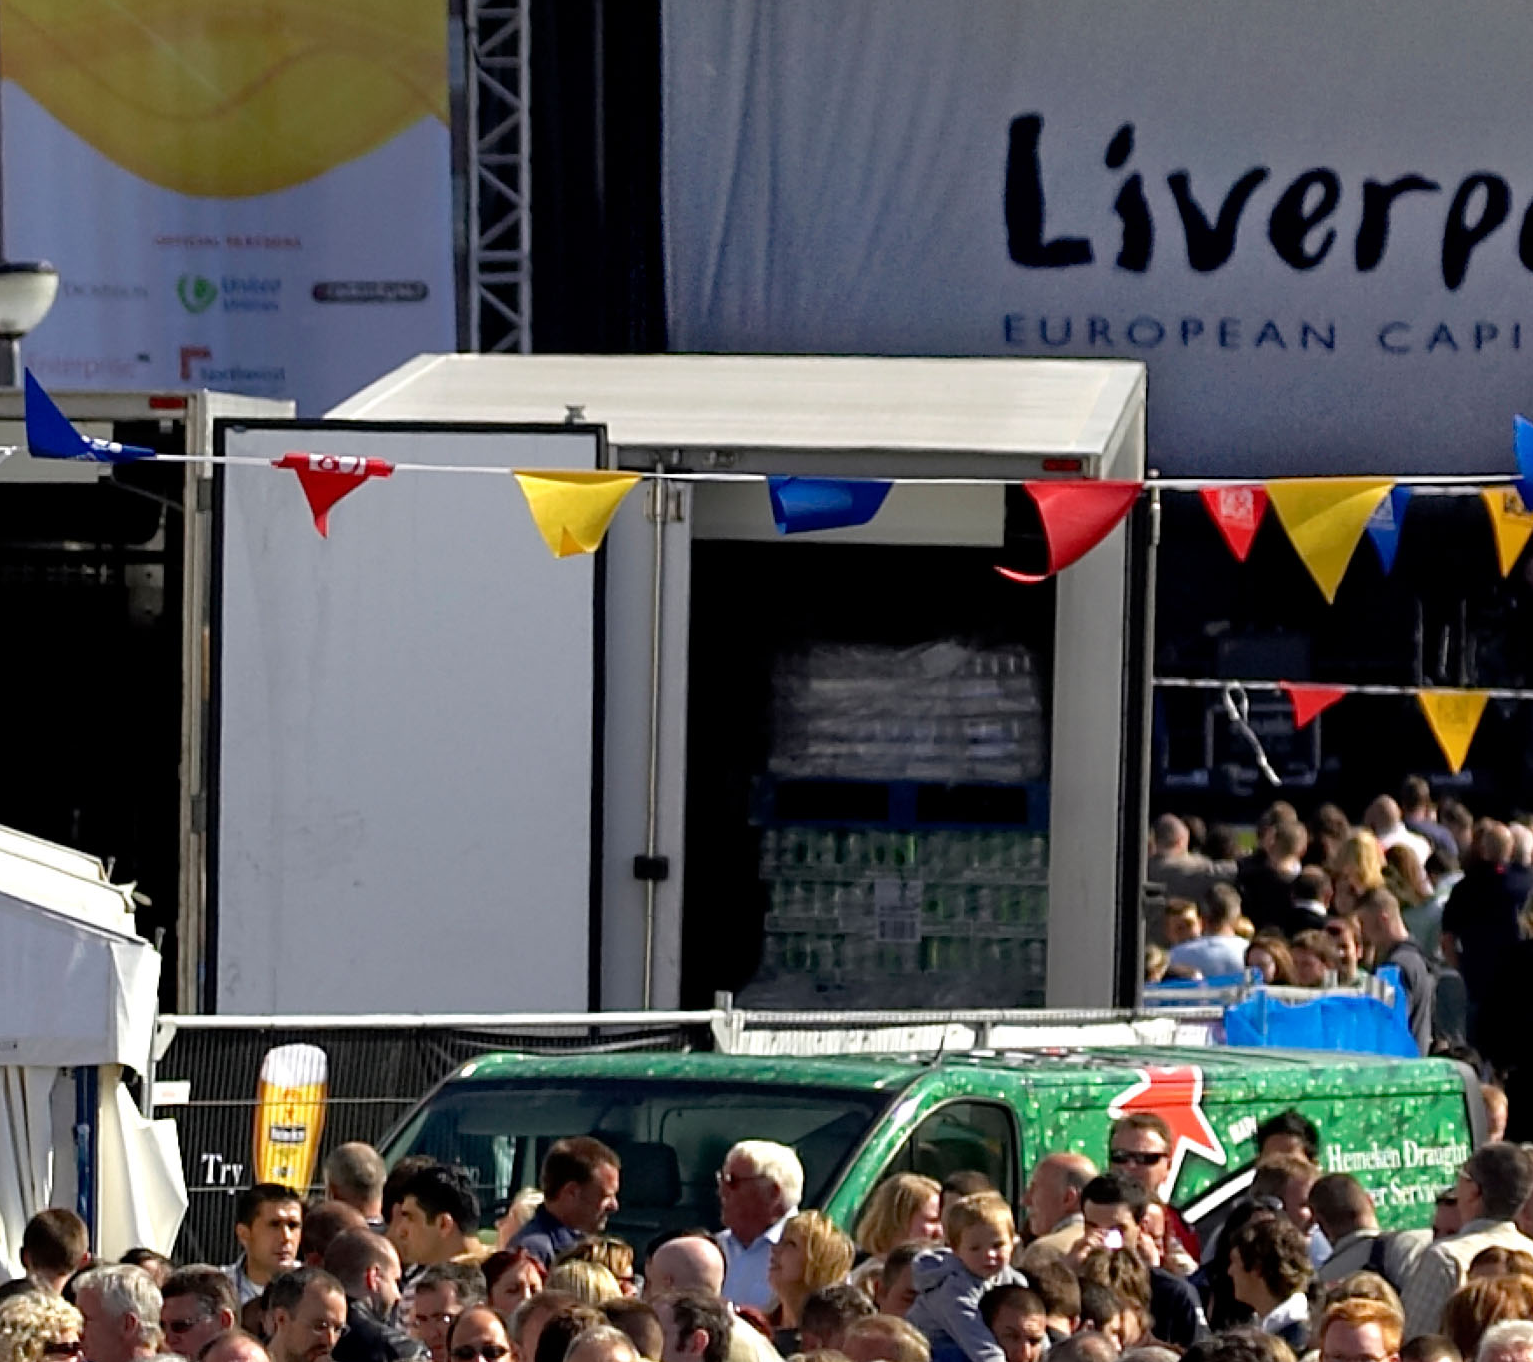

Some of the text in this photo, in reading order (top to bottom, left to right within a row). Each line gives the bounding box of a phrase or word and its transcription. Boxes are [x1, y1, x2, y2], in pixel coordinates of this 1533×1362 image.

[1003, 313, 1337, 354] EUROPEAN
[201, 1153, 244, 1194] Try
[1403, 1138, 1467, 1174] Draught
